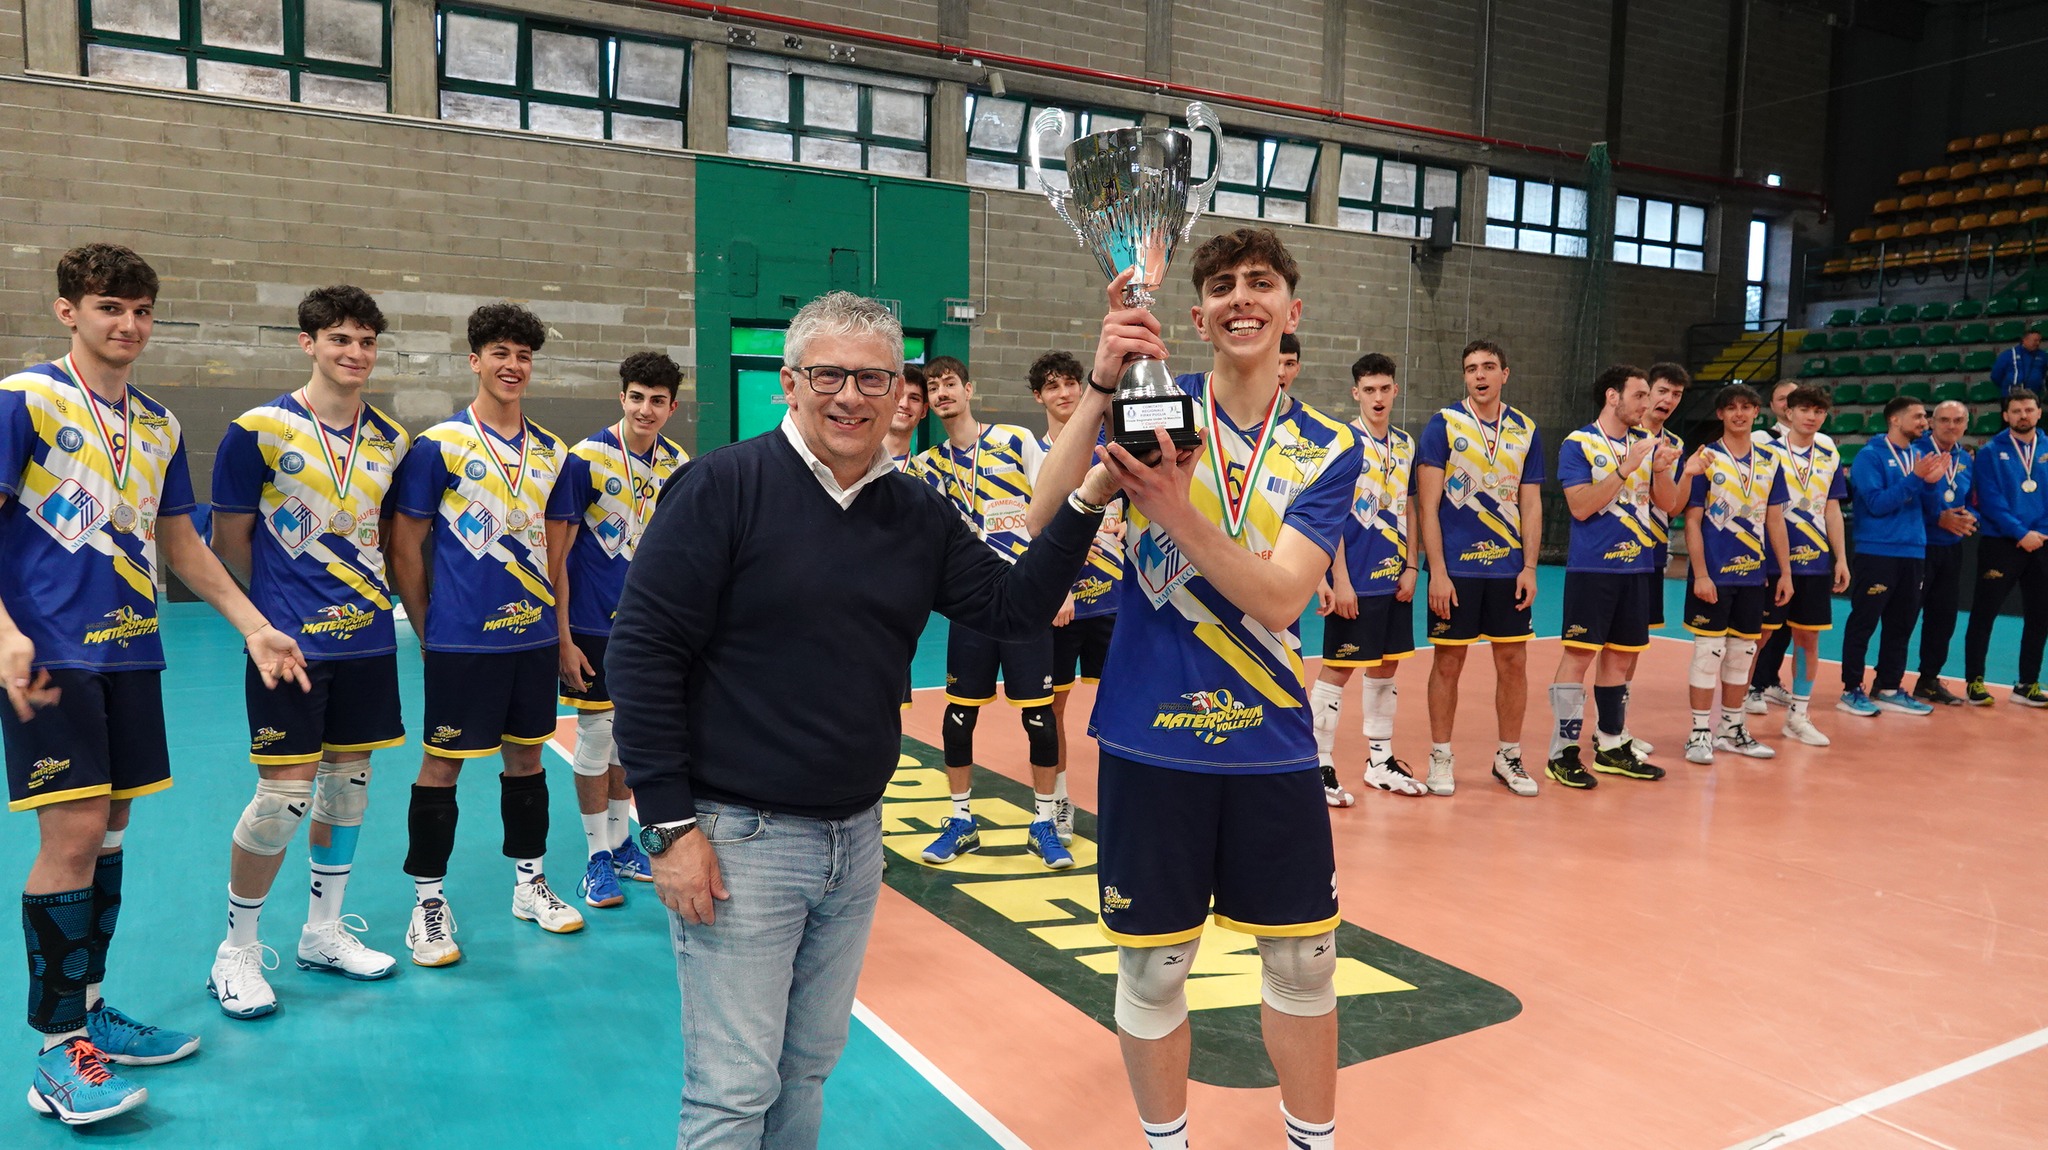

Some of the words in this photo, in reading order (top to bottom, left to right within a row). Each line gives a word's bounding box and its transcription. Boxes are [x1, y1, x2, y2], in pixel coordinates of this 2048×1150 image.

[633, 476, 655, 499] 26
[70, 514, 109, 549] MARTINUCCI
[1154, 566, 1196, 607] MARTINUCCI
[1216, 717, 1264, 733] VOLLEY.IT
